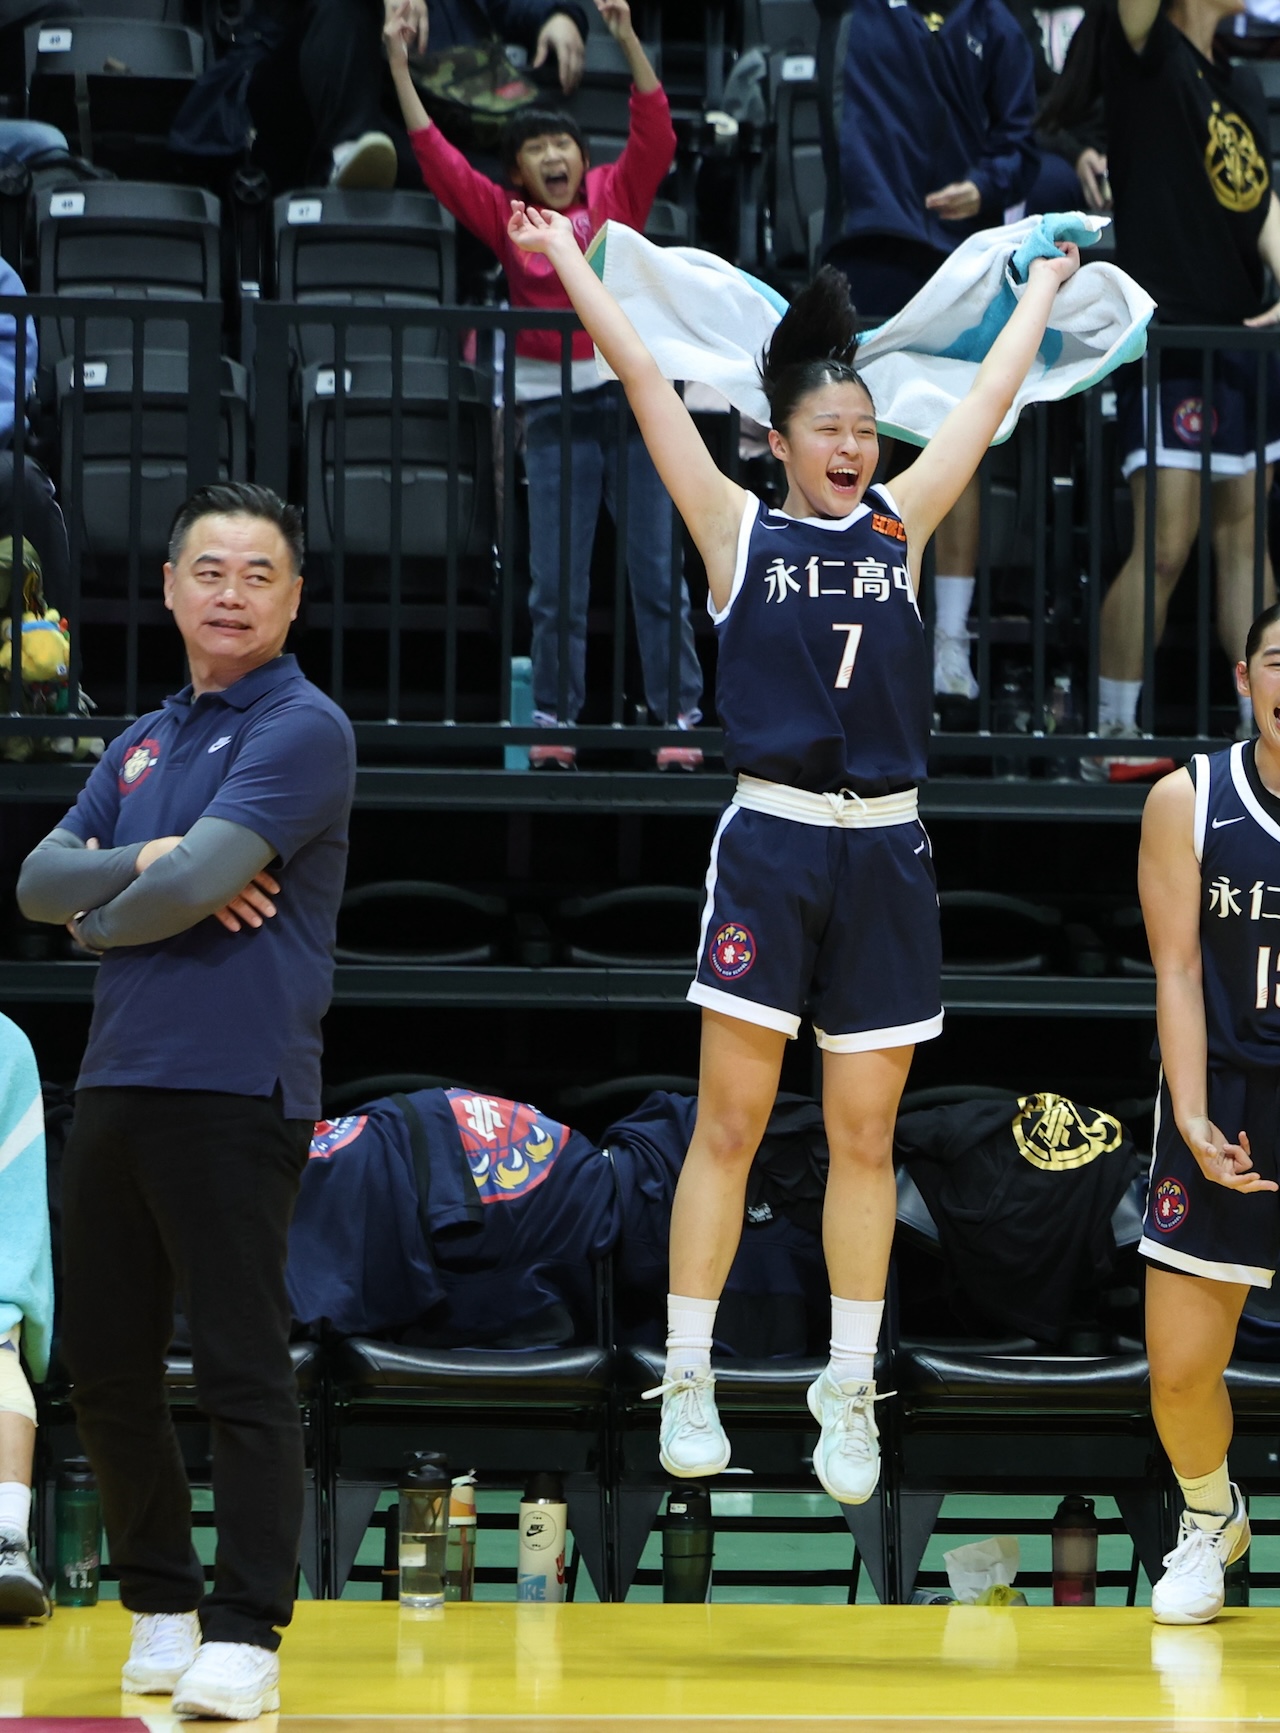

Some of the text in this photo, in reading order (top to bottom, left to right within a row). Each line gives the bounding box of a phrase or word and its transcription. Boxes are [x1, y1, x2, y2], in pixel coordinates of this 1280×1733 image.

[871, 513, 906, 542] HBL
[764, 556, 914, 604] 永仁高中
[832, 623, 863, 689] 7
